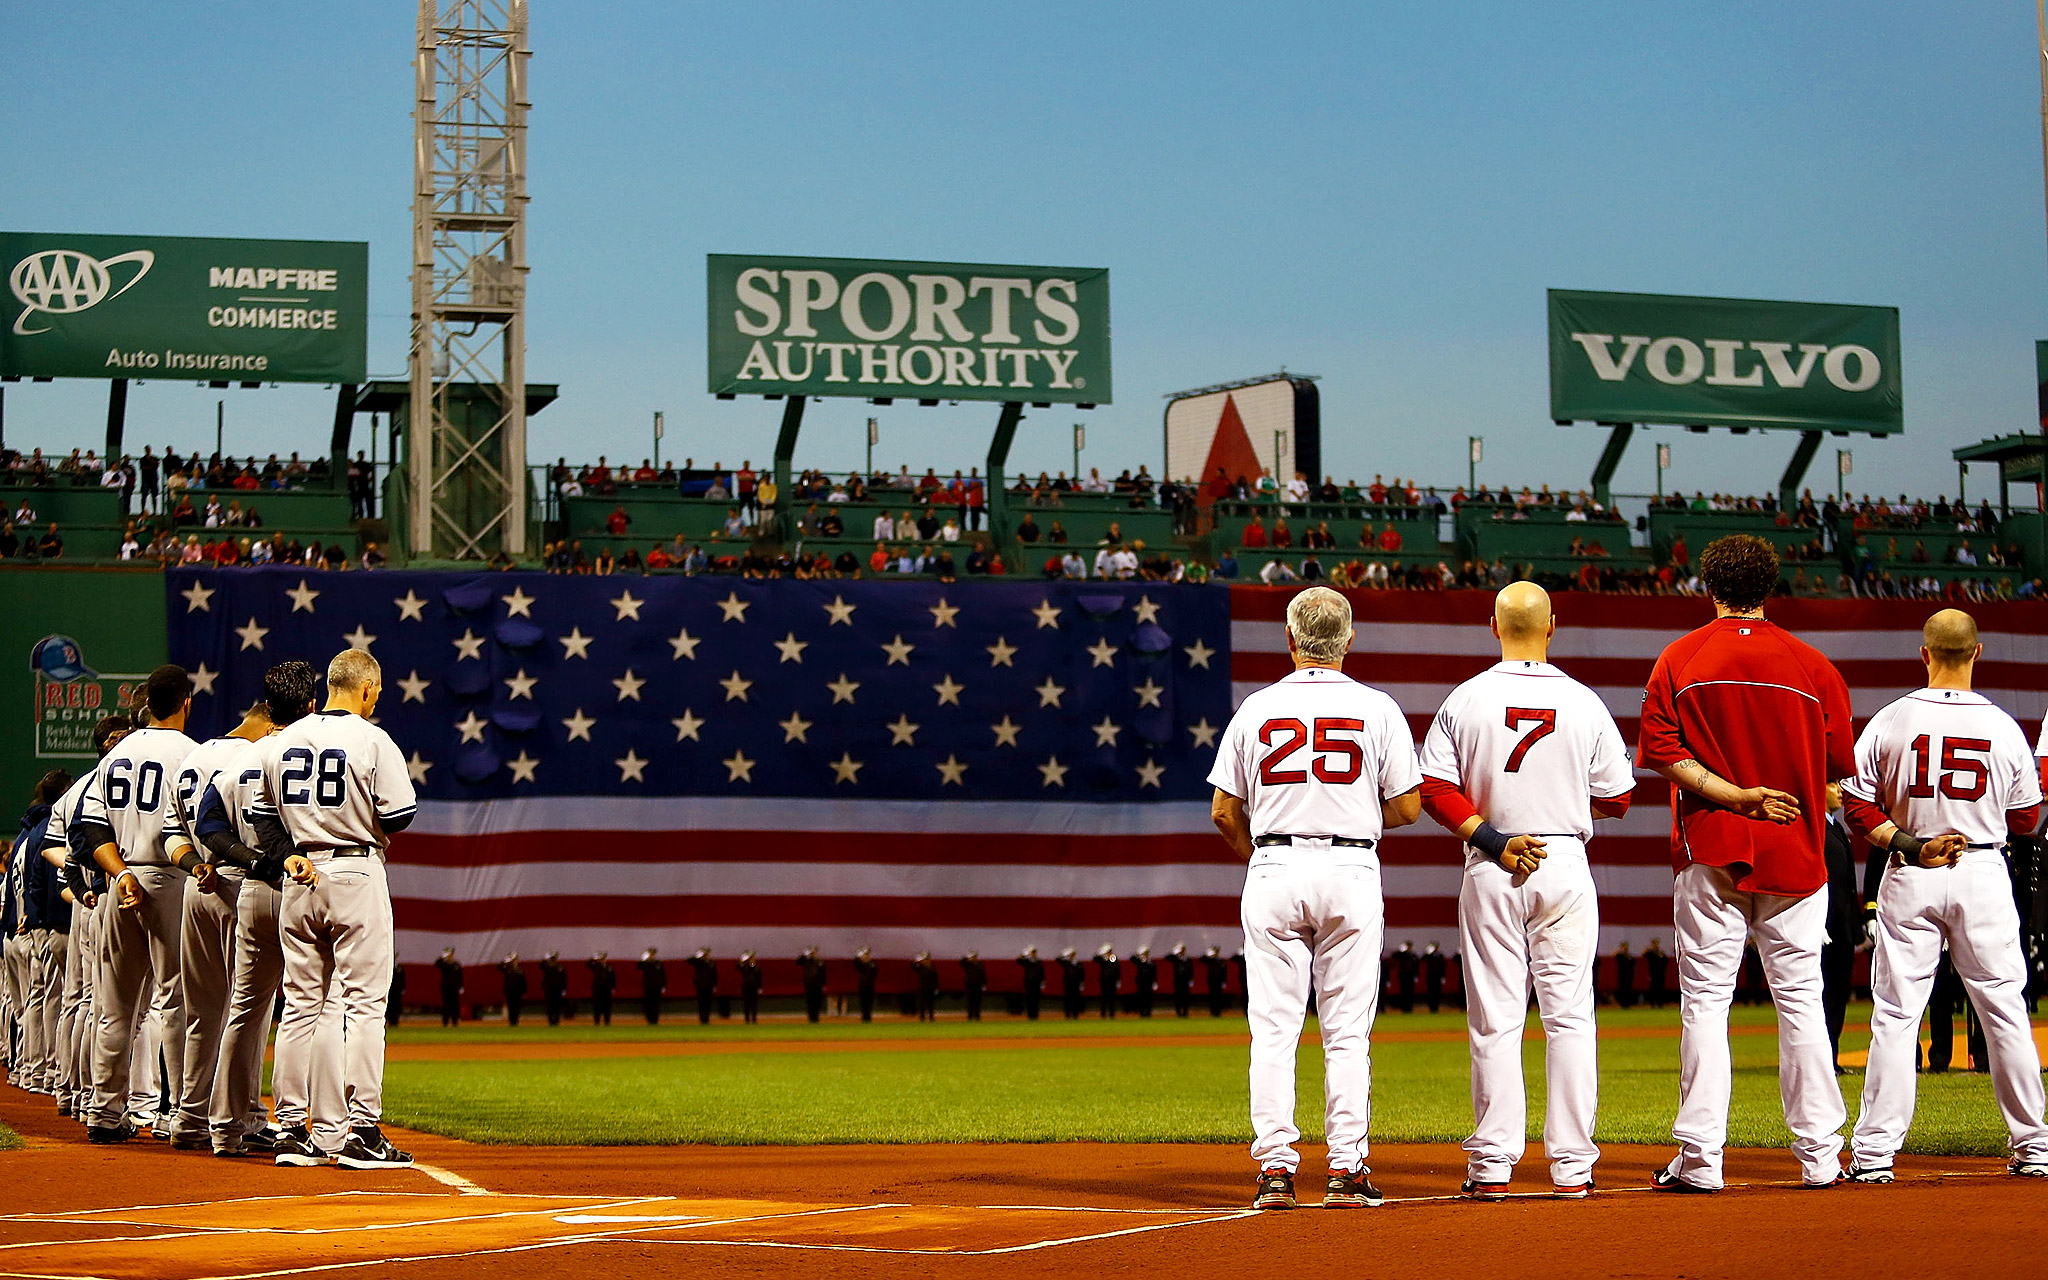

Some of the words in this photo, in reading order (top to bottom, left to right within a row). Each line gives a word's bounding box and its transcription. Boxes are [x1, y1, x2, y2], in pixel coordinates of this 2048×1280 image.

[19, 251, 102, 310] AAA
[209, 266, 338, 291] MAPFRE
[734, 267, 1080, 345] SPORTS
[208, 306, 338, 330] COMMERCE
[105, 347, 160, 369] Auto
[165, 349, 269, 371] Insurance
[736, 340, 1079, 389] AUTHORITY
[1572, 332, 1882, 392] VOLVO
[45, 682, 102, 709] RED
[46, 737, 92, 750] Medical
[1258, 717, 1365, 786] 25
[1504, 707, 1557, 773] 7
[1908, 733, 1992, 802] 15
[105, 757, 165, 814] 60
[178, 768, 223, 822] 2
[281, 747, 348, 808] 28
